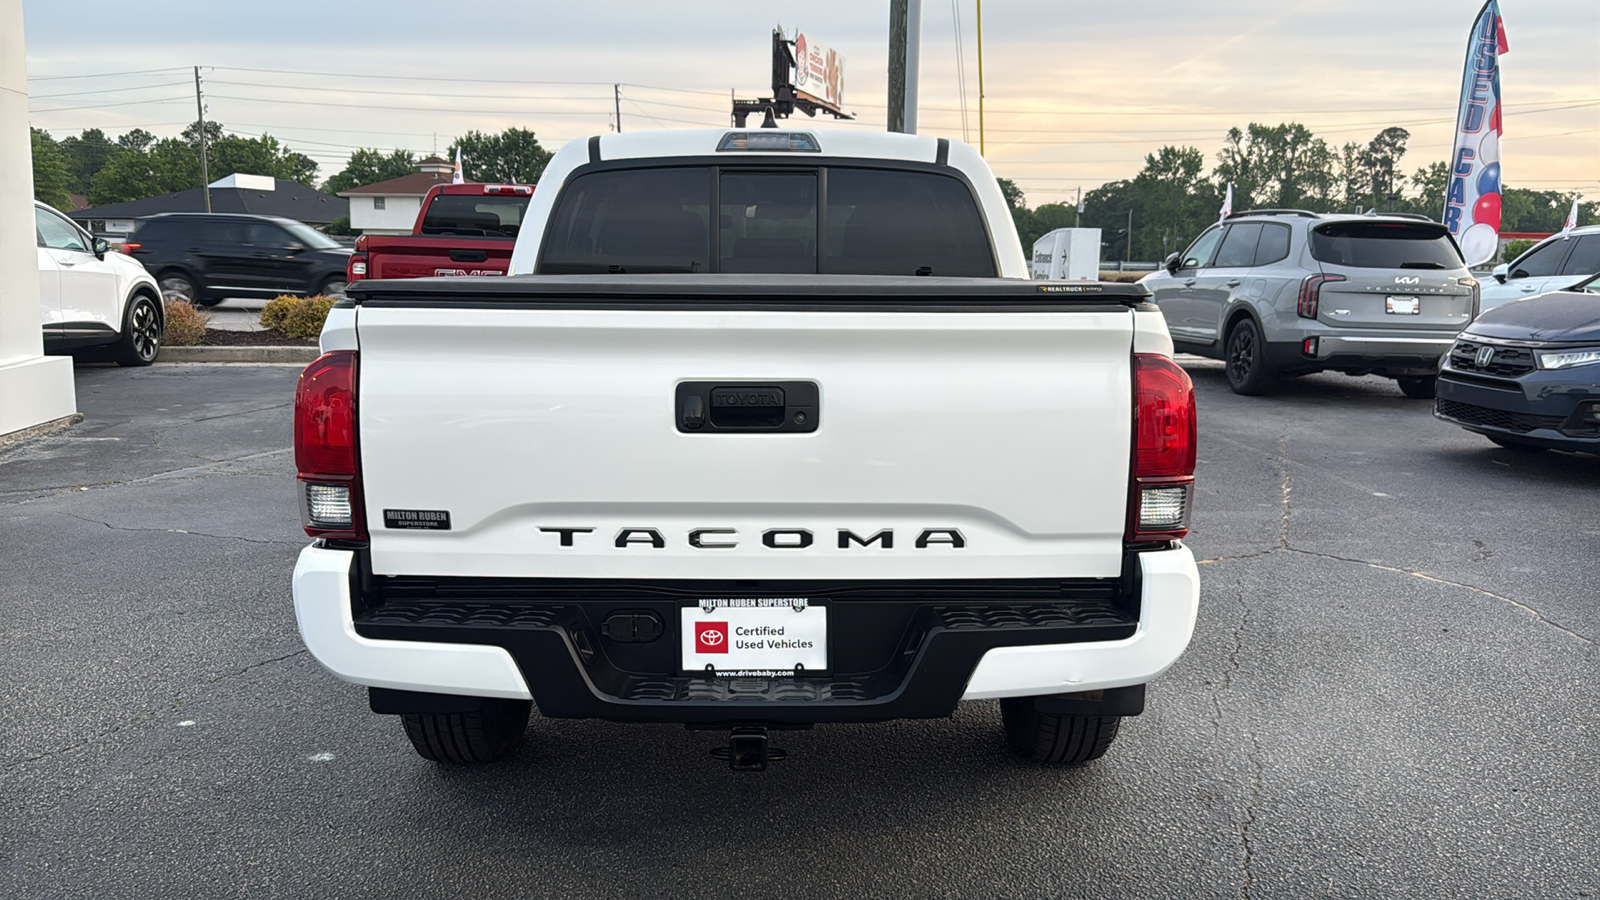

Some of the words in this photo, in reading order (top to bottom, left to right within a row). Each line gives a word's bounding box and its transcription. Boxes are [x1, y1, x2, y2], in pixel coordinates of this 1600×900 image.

[1461, 10, 1497, 133] USED
[1446, 147, 1477, 240] CAR
[716, 393, 779, 405] TOYOTA
[386, 511, 418, 520] MILTON
[418, 511, 447, 521] RUBEN
[538, 526, 967, 549] TACOMA
[699, 599, 727, 608] MILTON
[729, 599, 756, 607] RUBEN
[757, 598, 808, 607] SUPERSTORE
[735, 625, 785, 636] Certified
[736, 640, 764, 649] Used
[766, 639, 813, 649] Vehicles
